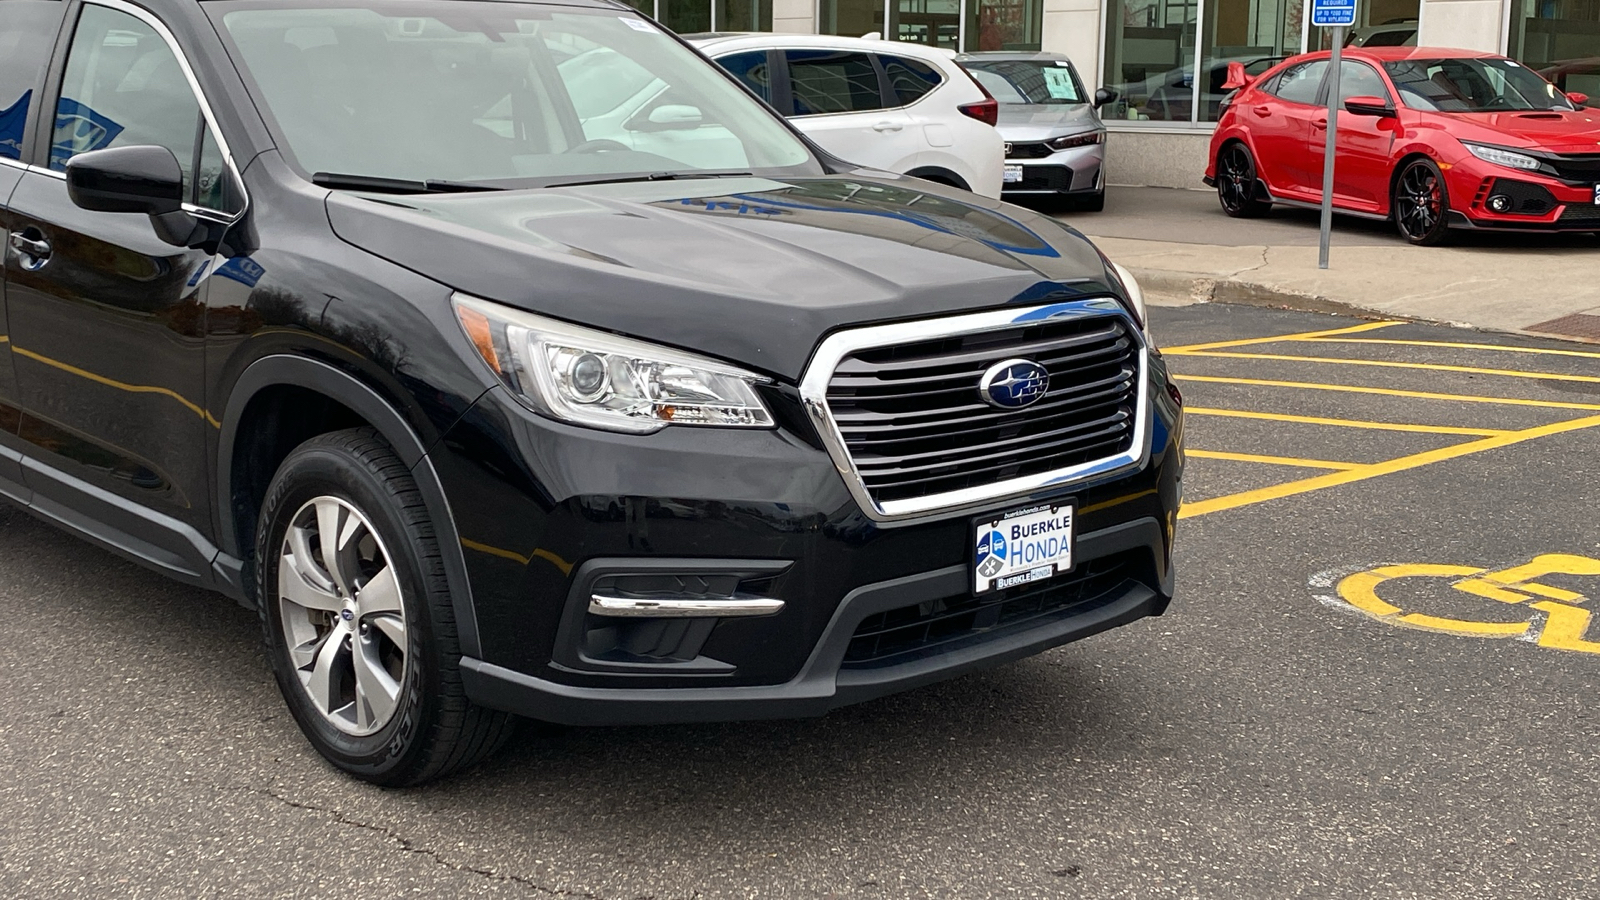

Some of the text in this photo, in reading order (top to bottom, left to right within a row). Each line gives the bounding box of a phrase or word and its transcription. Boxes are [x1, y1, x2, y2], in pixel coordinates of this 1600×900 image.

[1011, 515, 1071, 541] BUERKLE
[1010, 534, 1069, 567] HONDA
[998, 568, 1051, 588] BUERKLE HONDA
